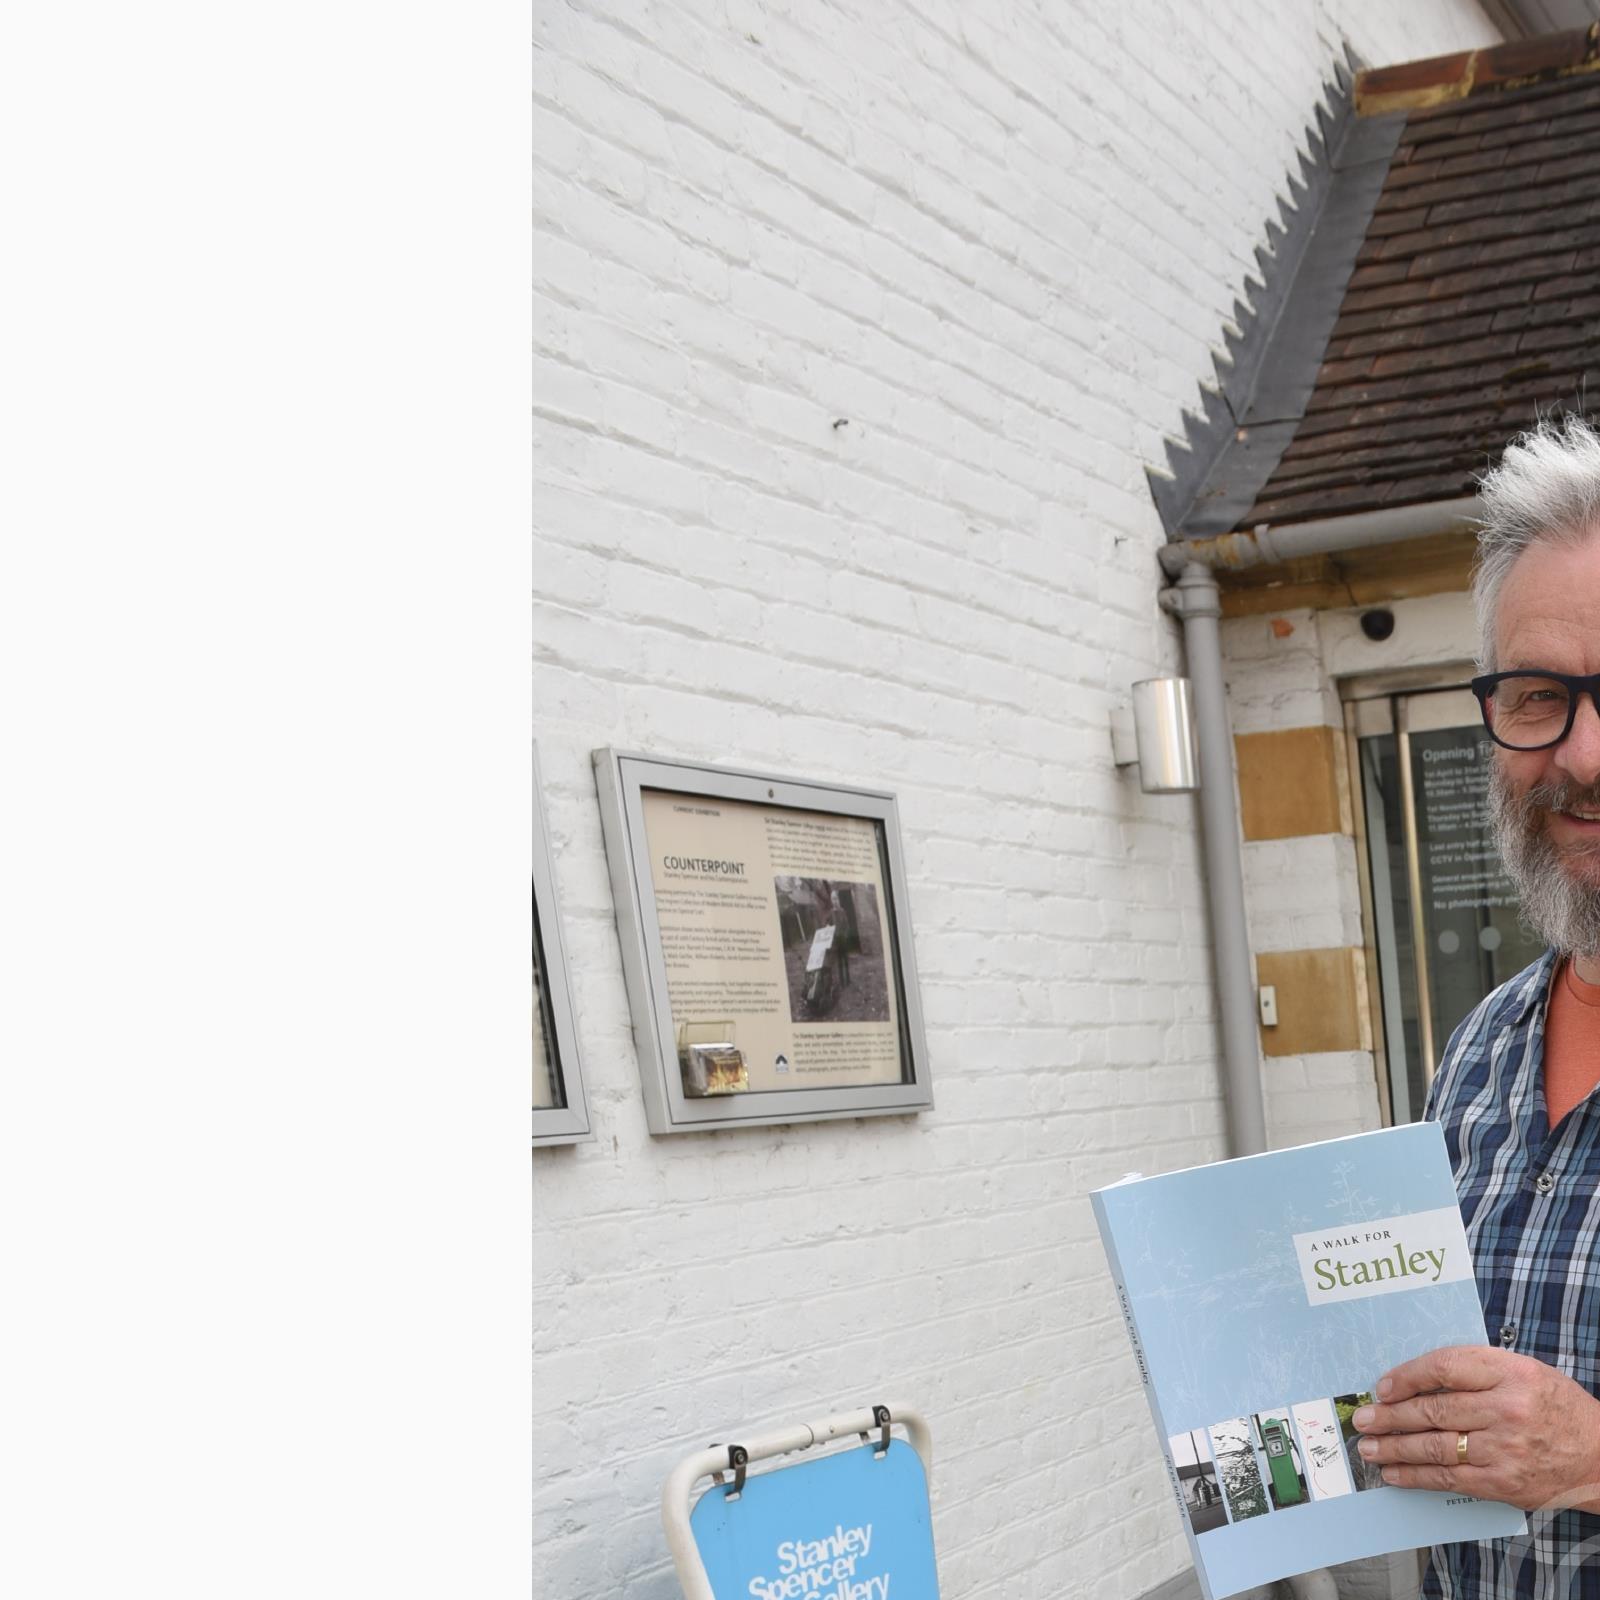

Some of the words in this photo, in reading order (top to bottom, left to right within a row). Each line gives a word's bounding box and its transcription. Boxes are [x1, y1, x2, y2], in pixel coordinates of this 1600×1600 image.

[1422, 747, 1475, 764] Opening
[663, 855, 745, 875] COUNTERPOINT
[1311, 1243, 1319, 1252] A
[1323, 1235, 1360, 1250] WALK
[1365, 1230, 1392, 1242] FOR
[1313, 1242, 1446, 1291] Stanley
[777, 1523, 873, 1575] Stanley
